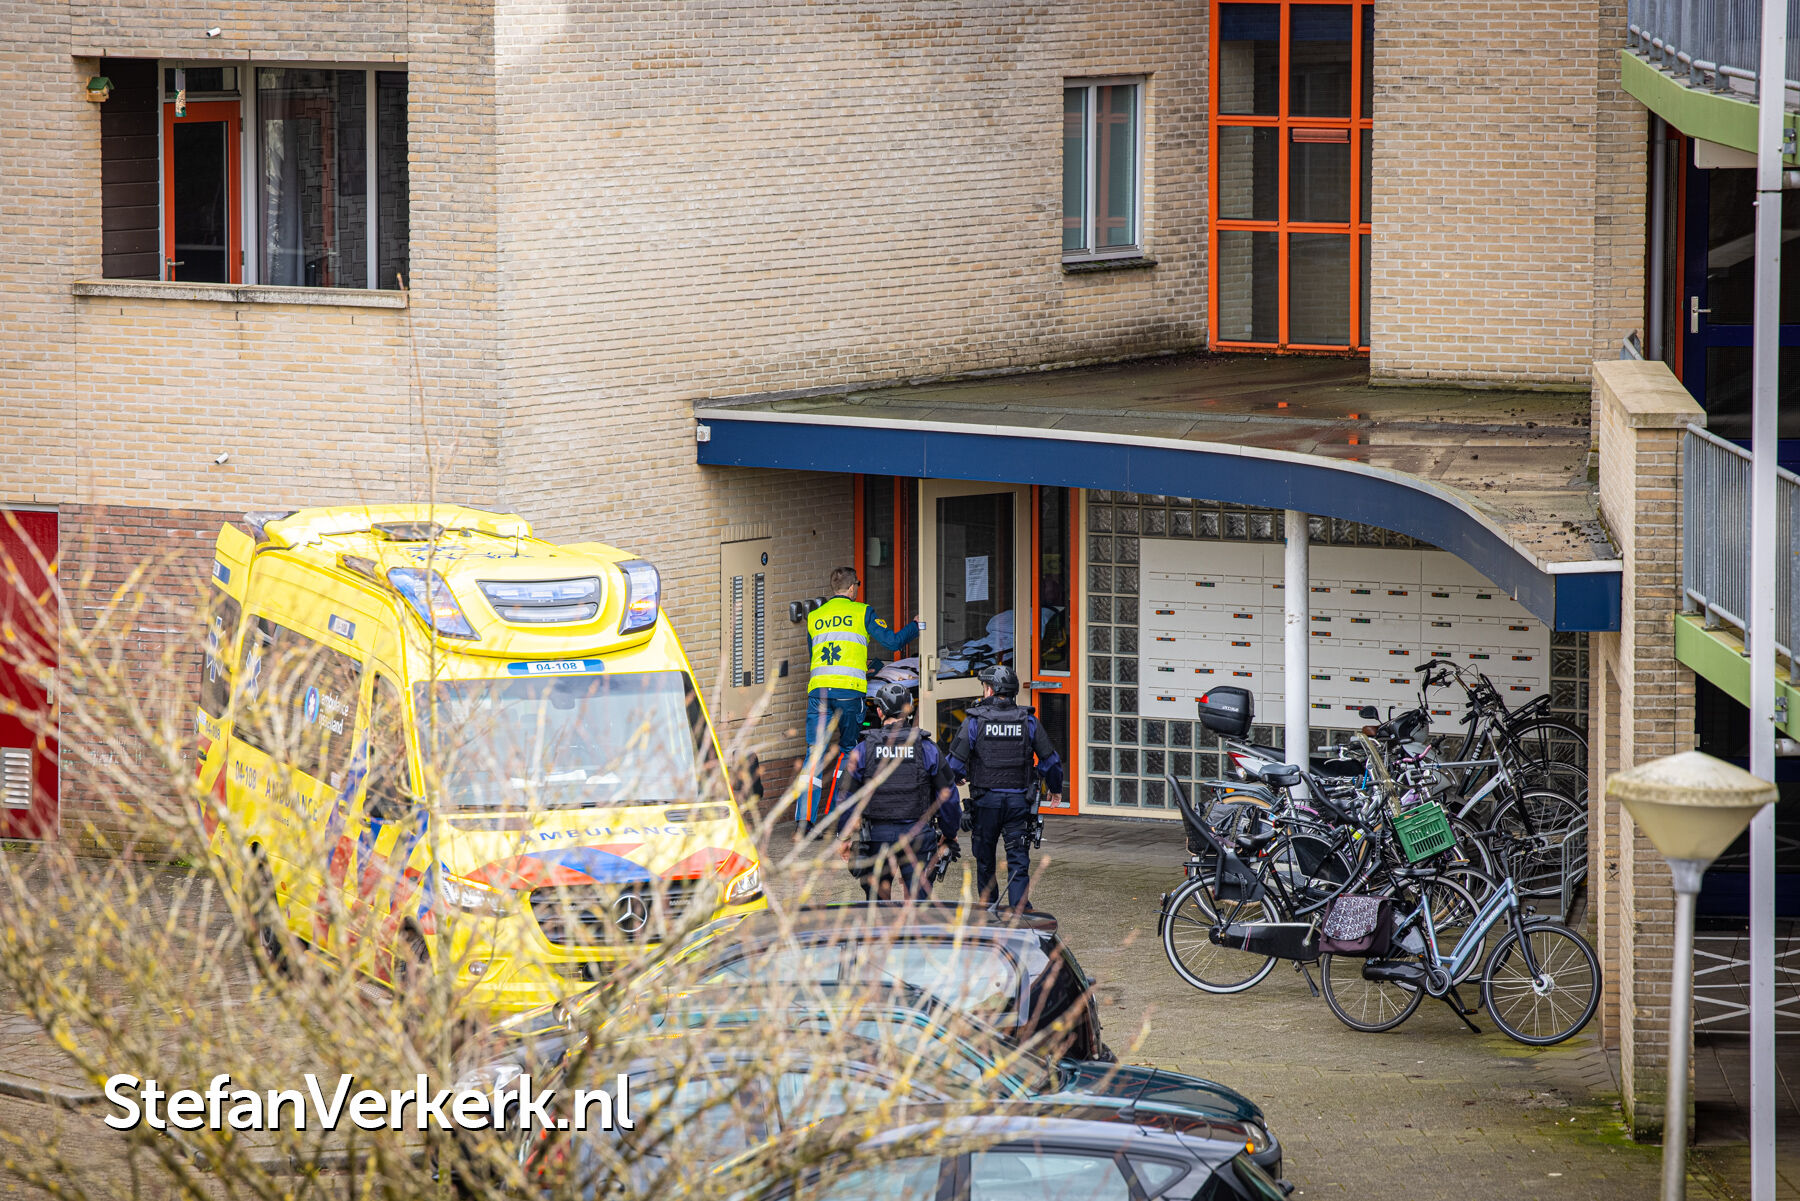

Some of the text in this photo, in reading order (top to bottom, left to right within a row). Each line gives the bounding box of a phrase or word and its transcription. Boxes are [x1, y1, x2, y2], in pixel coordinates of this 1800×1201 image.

[814, 615, 853, 630] OvDG
[536, 662, 578, 671] 04-108
[985, 724, 1022, 736] POLITIE
[876, 746, 914, 759] POLITIE
[520, 826, 697, 845] AMBULANCE
